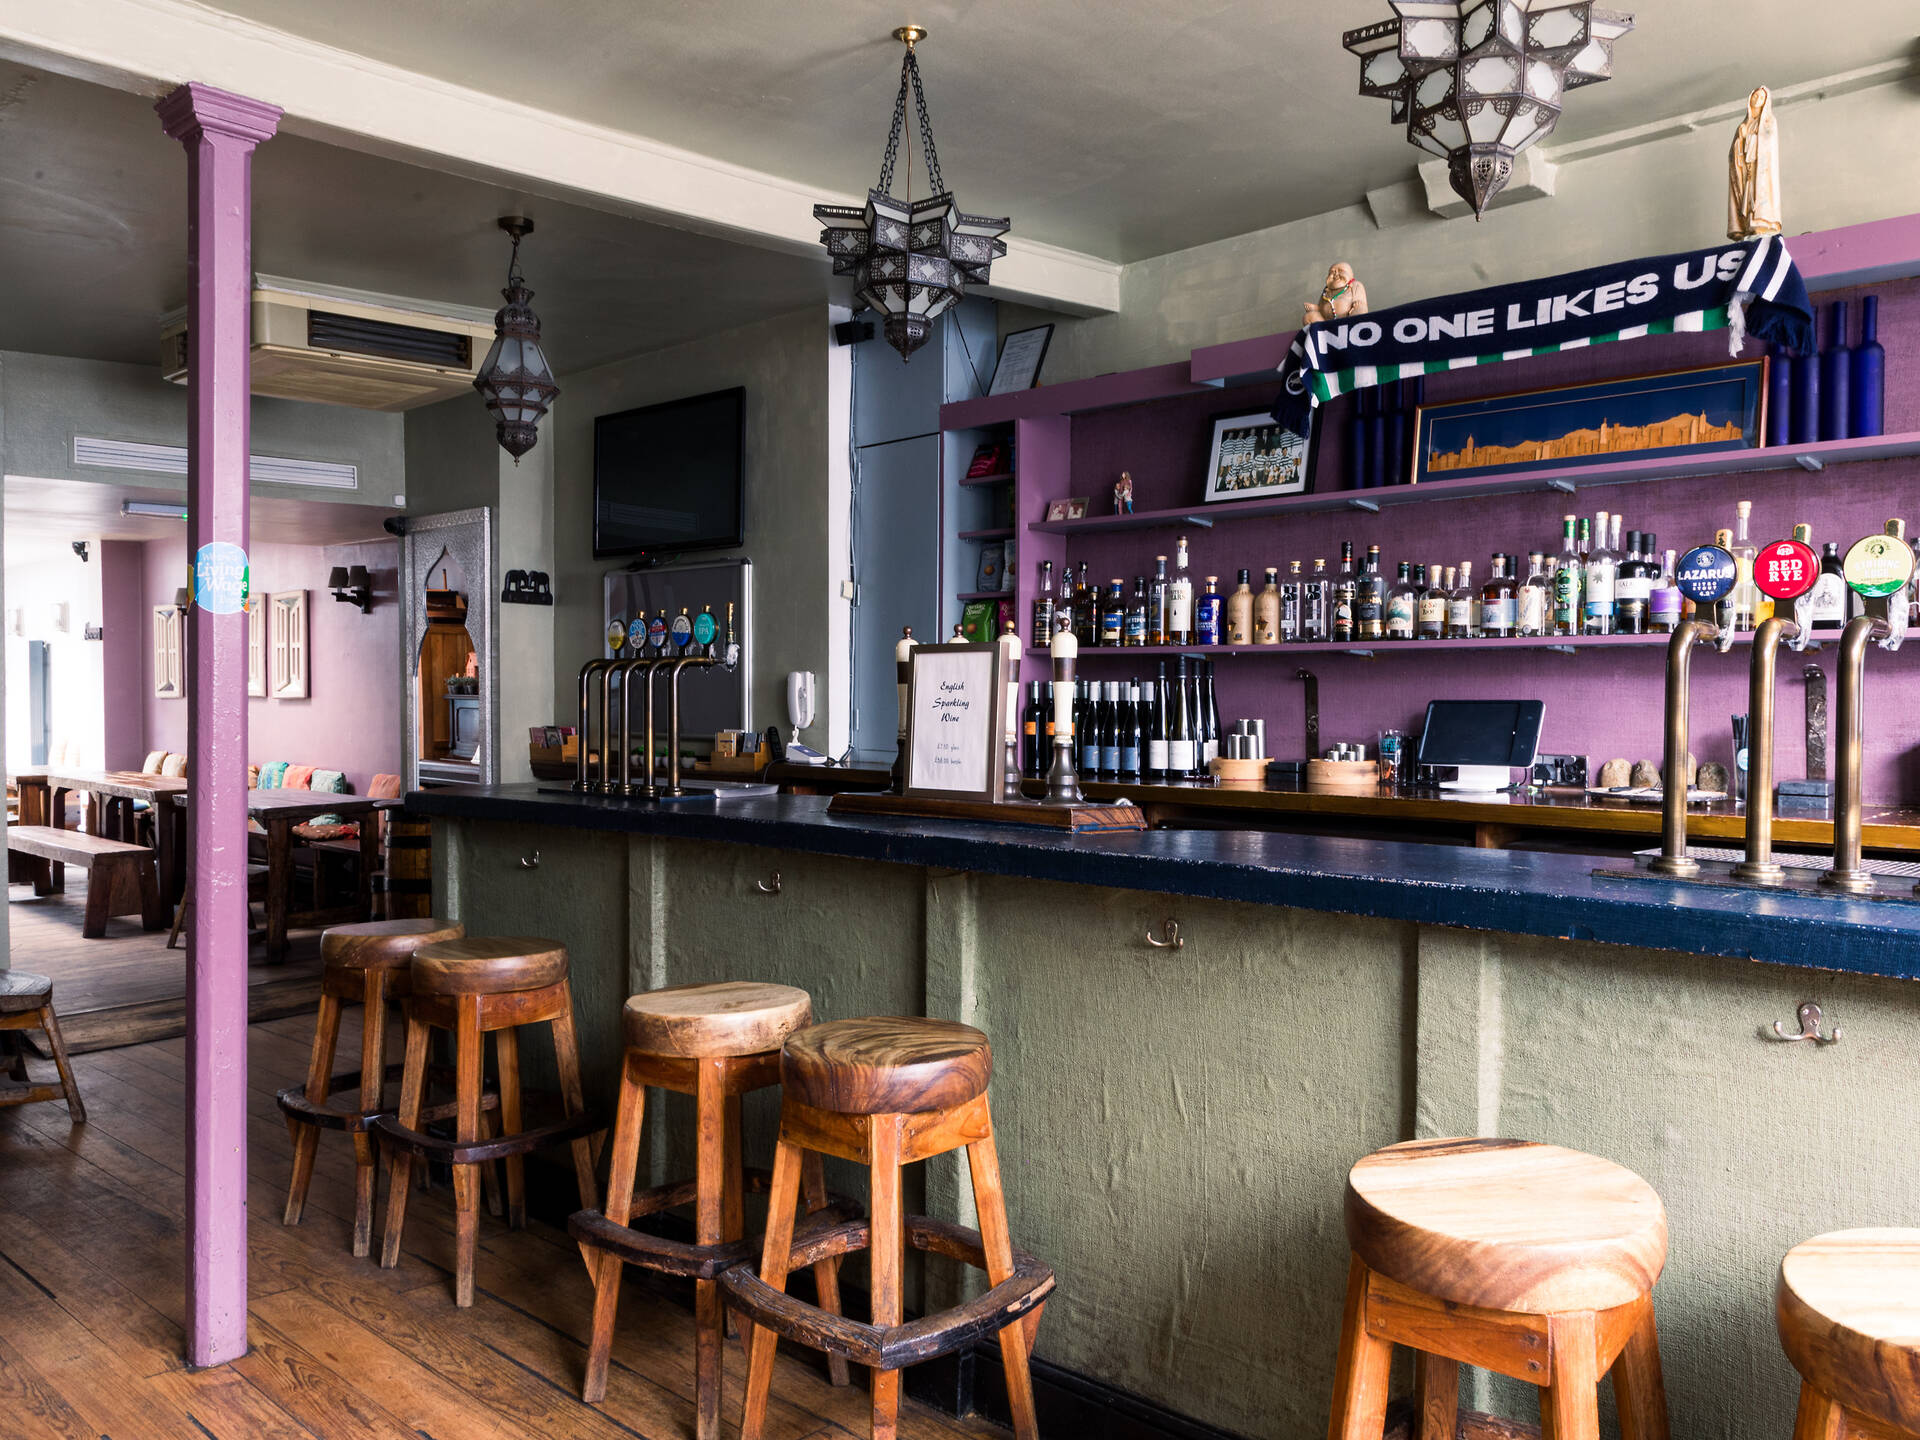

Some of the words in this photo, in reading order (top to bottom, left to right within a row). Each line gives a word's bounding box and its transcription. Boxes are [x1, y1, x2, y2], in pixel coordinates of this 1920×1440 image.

[1317, 321, 1382, 355] NO
[1393, 308, 1494, 344] ONE
[1506, 272, 1660, 332] LIKES
[1673, 249, 1746, 291] US
[196, 562, 245, 580] Living
[1768, 559, 1803, 571] RED
[1677, 568, 1732, 581] LAZARUS
[1768, 570, 1803, 582] RYE
[205, 577, 248, 596] Wage
[940, 681, 964, 693] English
[932, 697, 969, 710] Sparkling
[941, 713, 960, 722] Wine
